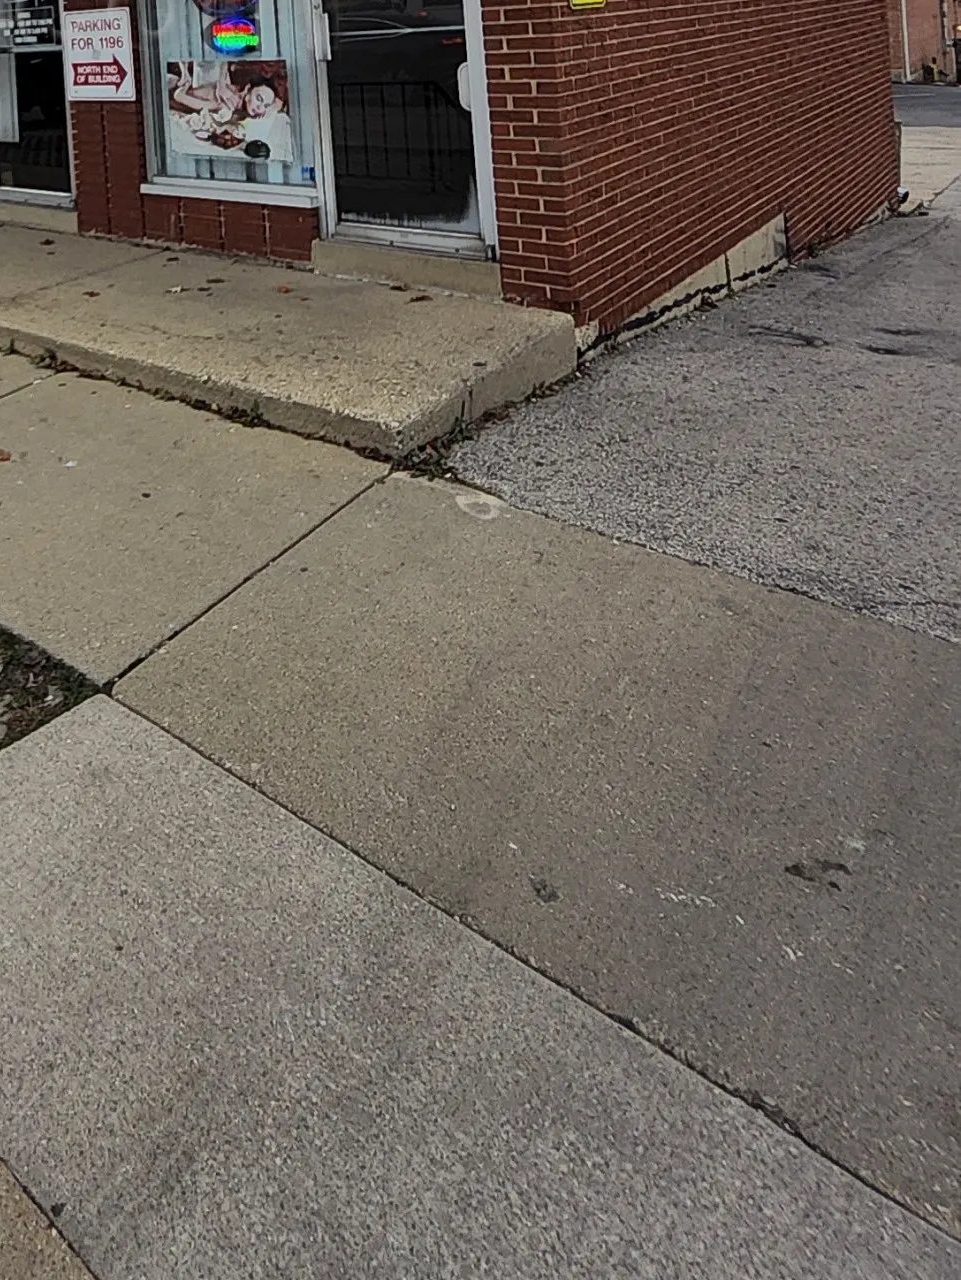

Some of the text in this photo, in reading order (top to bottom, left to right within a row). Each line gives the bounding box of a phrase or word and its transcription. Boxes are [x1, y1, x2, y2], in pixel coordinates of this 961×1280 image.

[70, 18, 122, 32] PARKING
[71, 36, 124, 51] FOR 1196
[77, 65, 118, 74] NORTH END
[77, 75, 121, 84] OF BUILDING
